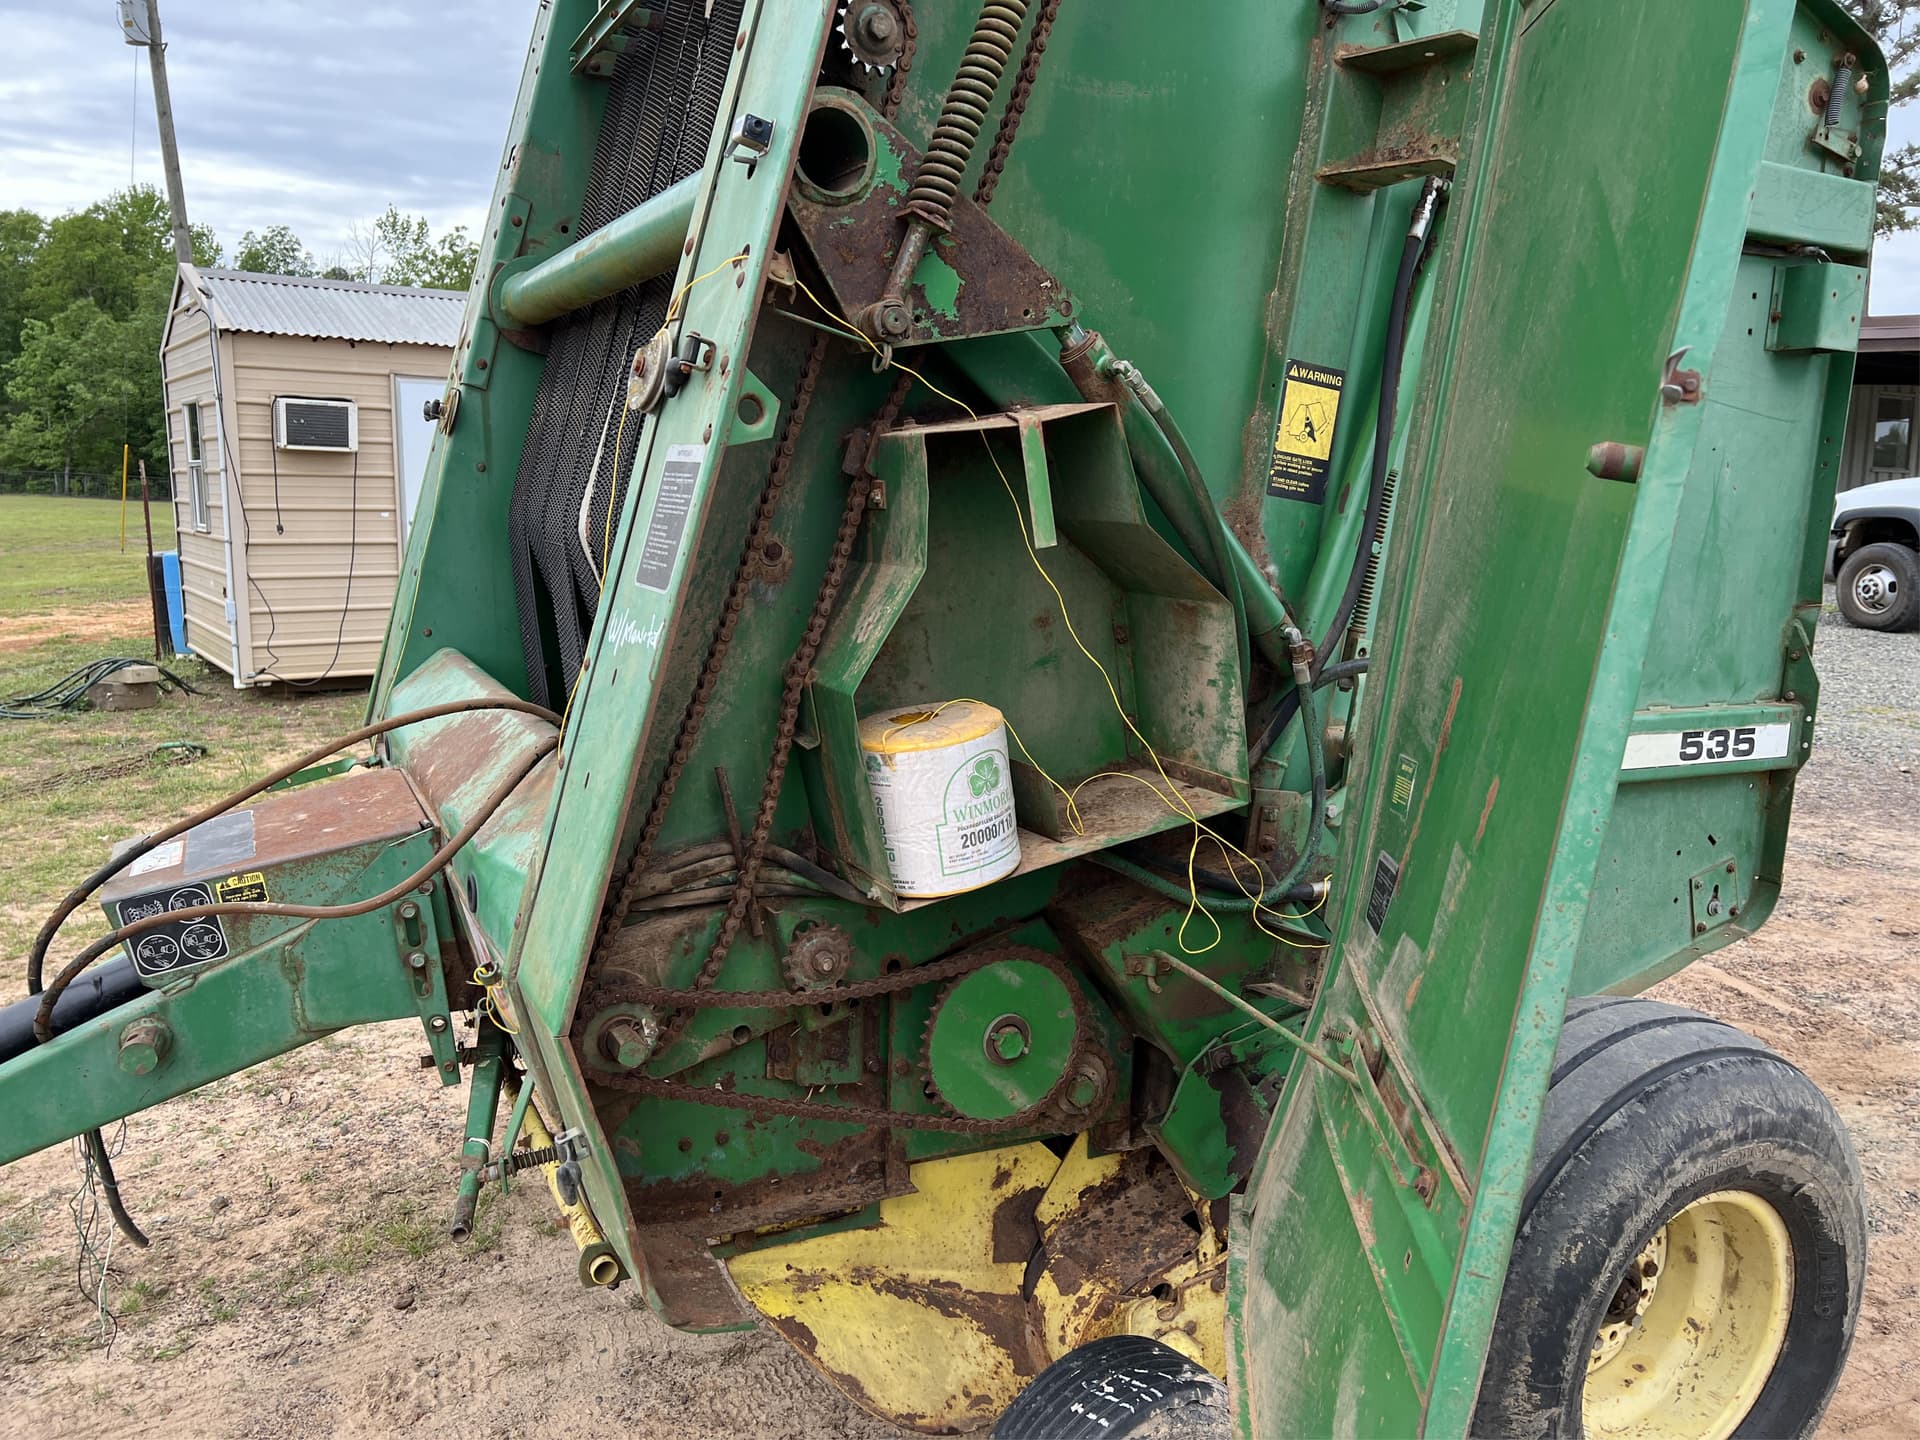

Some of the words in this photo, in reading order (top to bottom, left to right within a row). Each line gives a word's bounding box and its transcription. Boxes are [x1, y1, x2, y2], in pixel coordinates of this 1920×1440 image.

[1299, 368, 1343, 387] WARNING
[1679, 728, 1756, 761] 535
[953, 787, 1010, 822] WINMORE
[960, 812, 1013, 850] 20000/110
[232, 873, 261, 887] CAUTION
